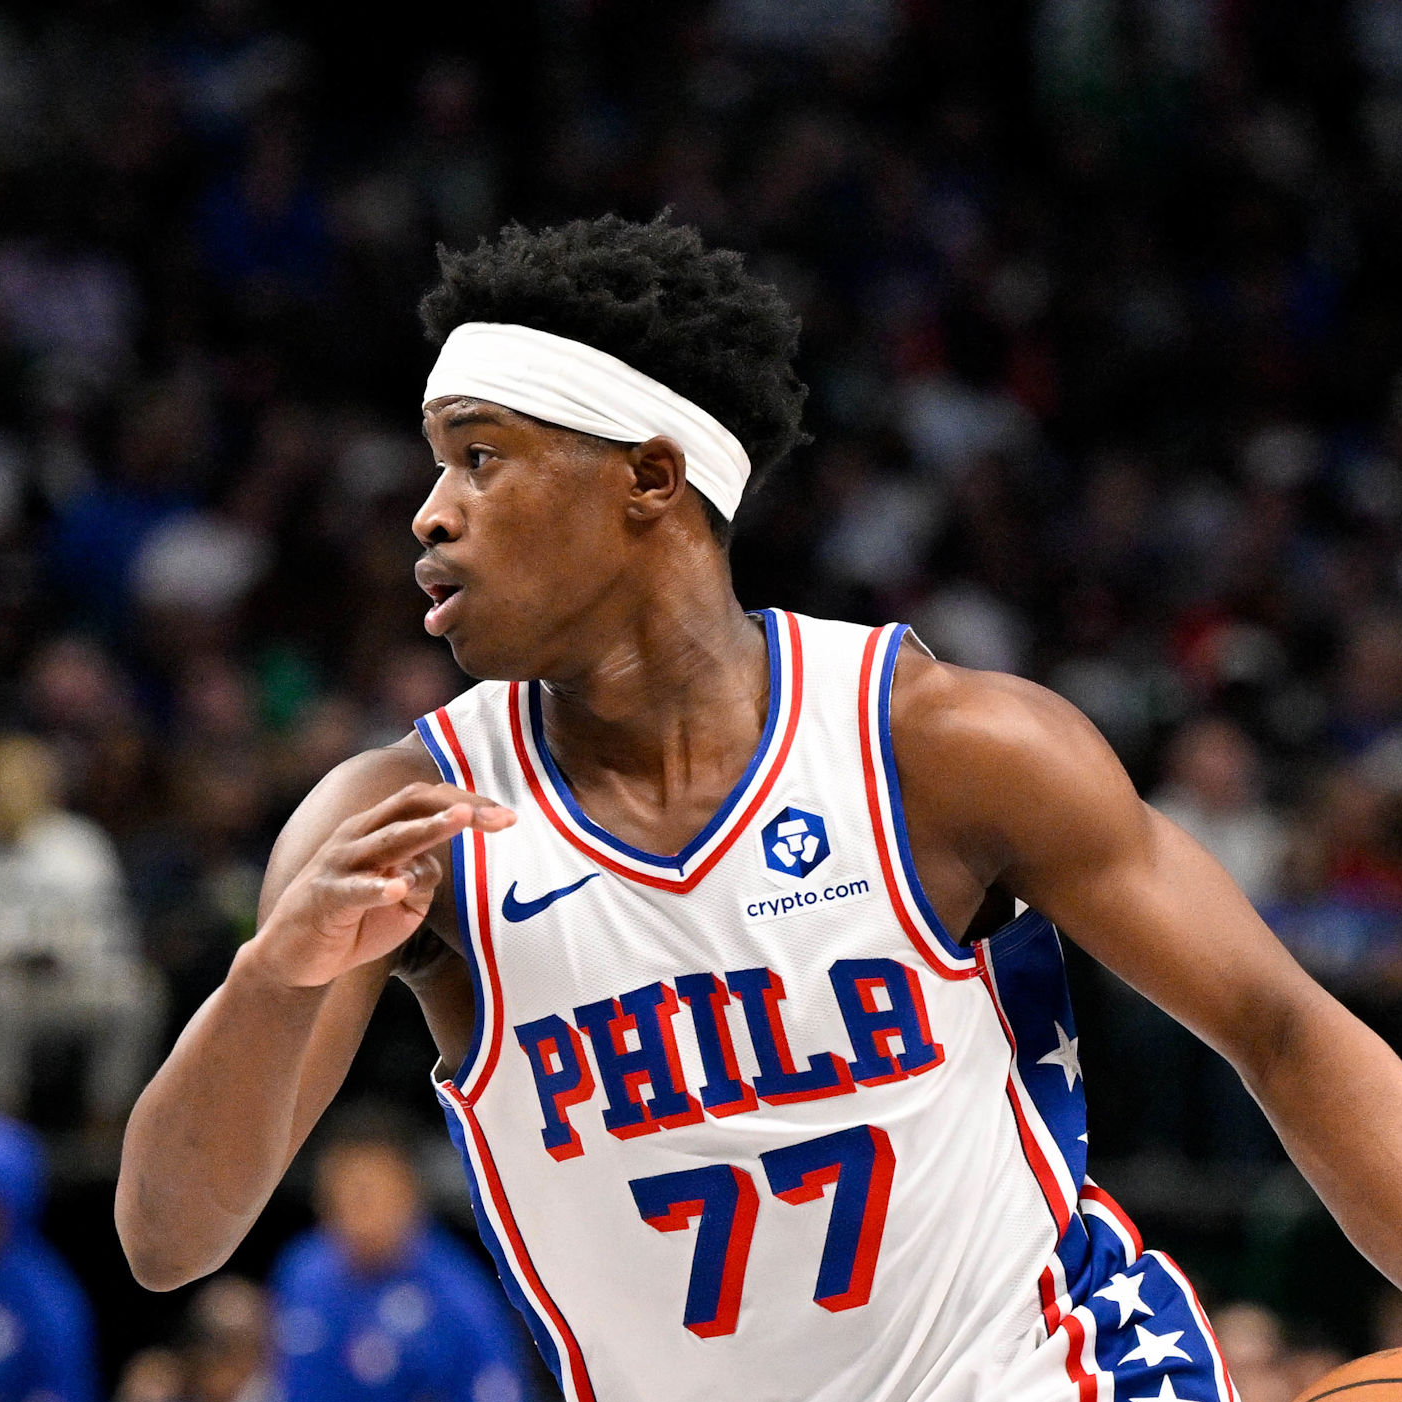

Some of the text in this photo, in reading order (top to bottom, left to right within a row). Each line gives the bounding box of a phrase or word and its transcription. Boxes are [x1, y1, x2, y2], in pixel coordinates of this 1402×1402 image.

[747, 879, 869, 917] crypto.com
[513, 958, 946, 1163] PHILA
[628, 1124, 897, 1340] 77
